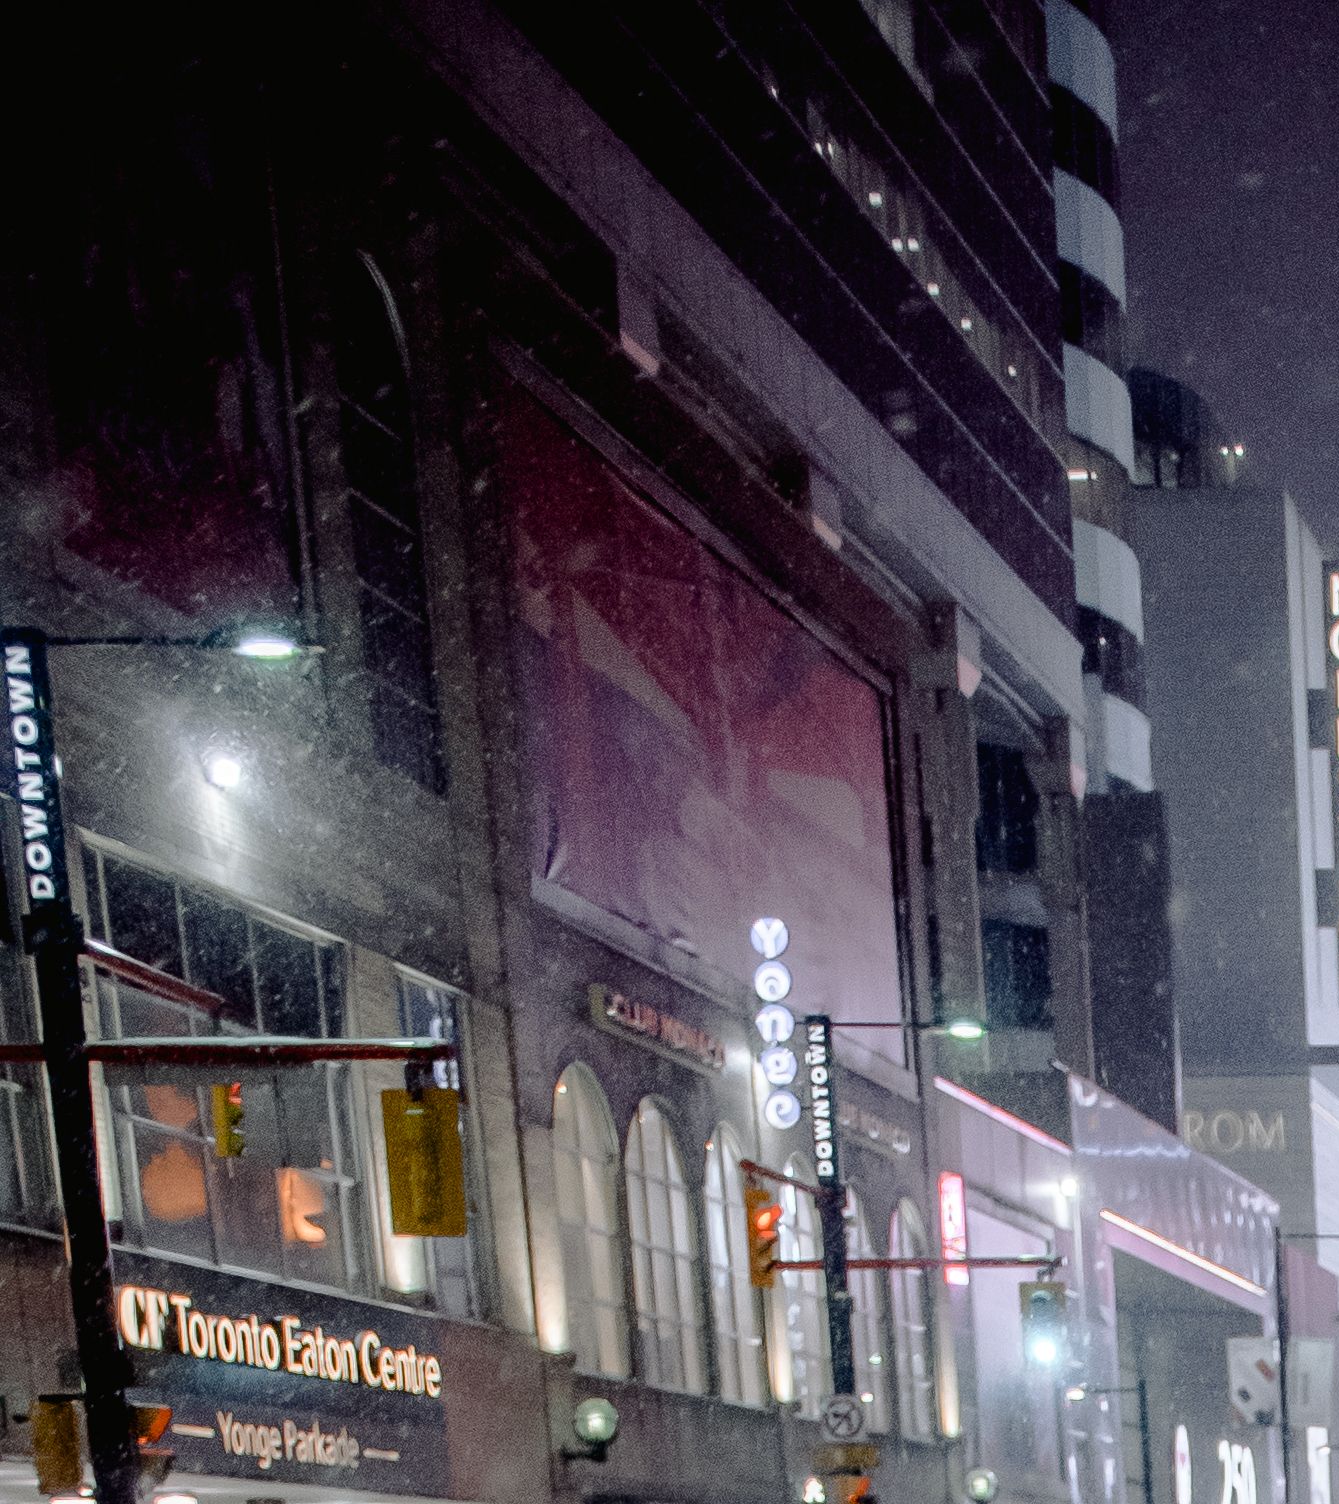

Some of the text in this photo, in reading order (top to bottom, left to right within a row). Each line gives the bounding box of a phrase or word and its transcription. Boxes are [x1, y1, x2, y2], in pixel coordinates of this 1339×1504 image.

[4, 644, 55, 900] DOWNTOWN
[749, 916, 804, 1130] Yonge
[807, 1024, 834, 1178] DOWNTOWN
[118, 1285, 442, 1398] CF Toronto Eaton Centre
[216, 1410, 360, 1470] Yonge Parkade
